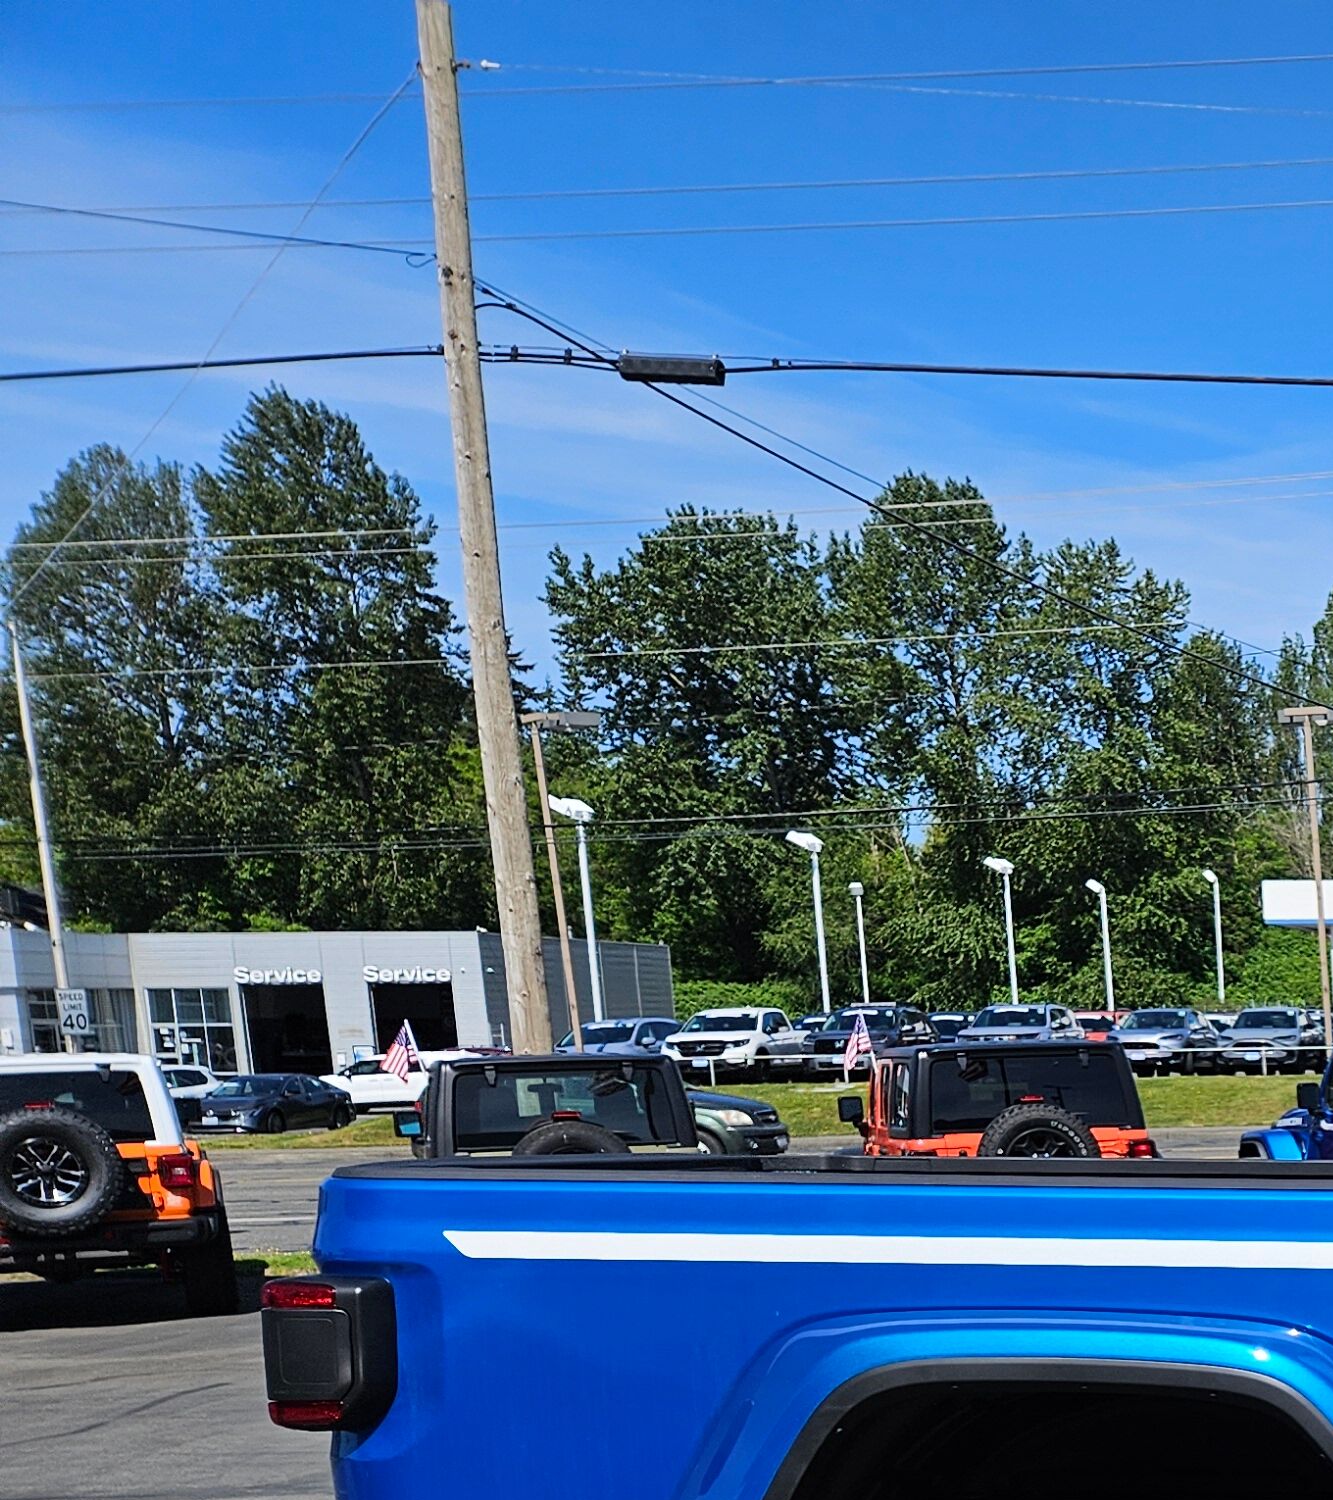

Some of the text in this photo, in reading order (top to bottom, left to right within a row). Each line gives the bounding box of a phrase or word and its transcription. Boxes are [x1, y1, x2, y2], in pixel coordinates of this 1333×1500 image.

[233, 966, 322, 984] Service
[362, 965, 452, 983] Service
[63, 1013, 87, 1030] 40
